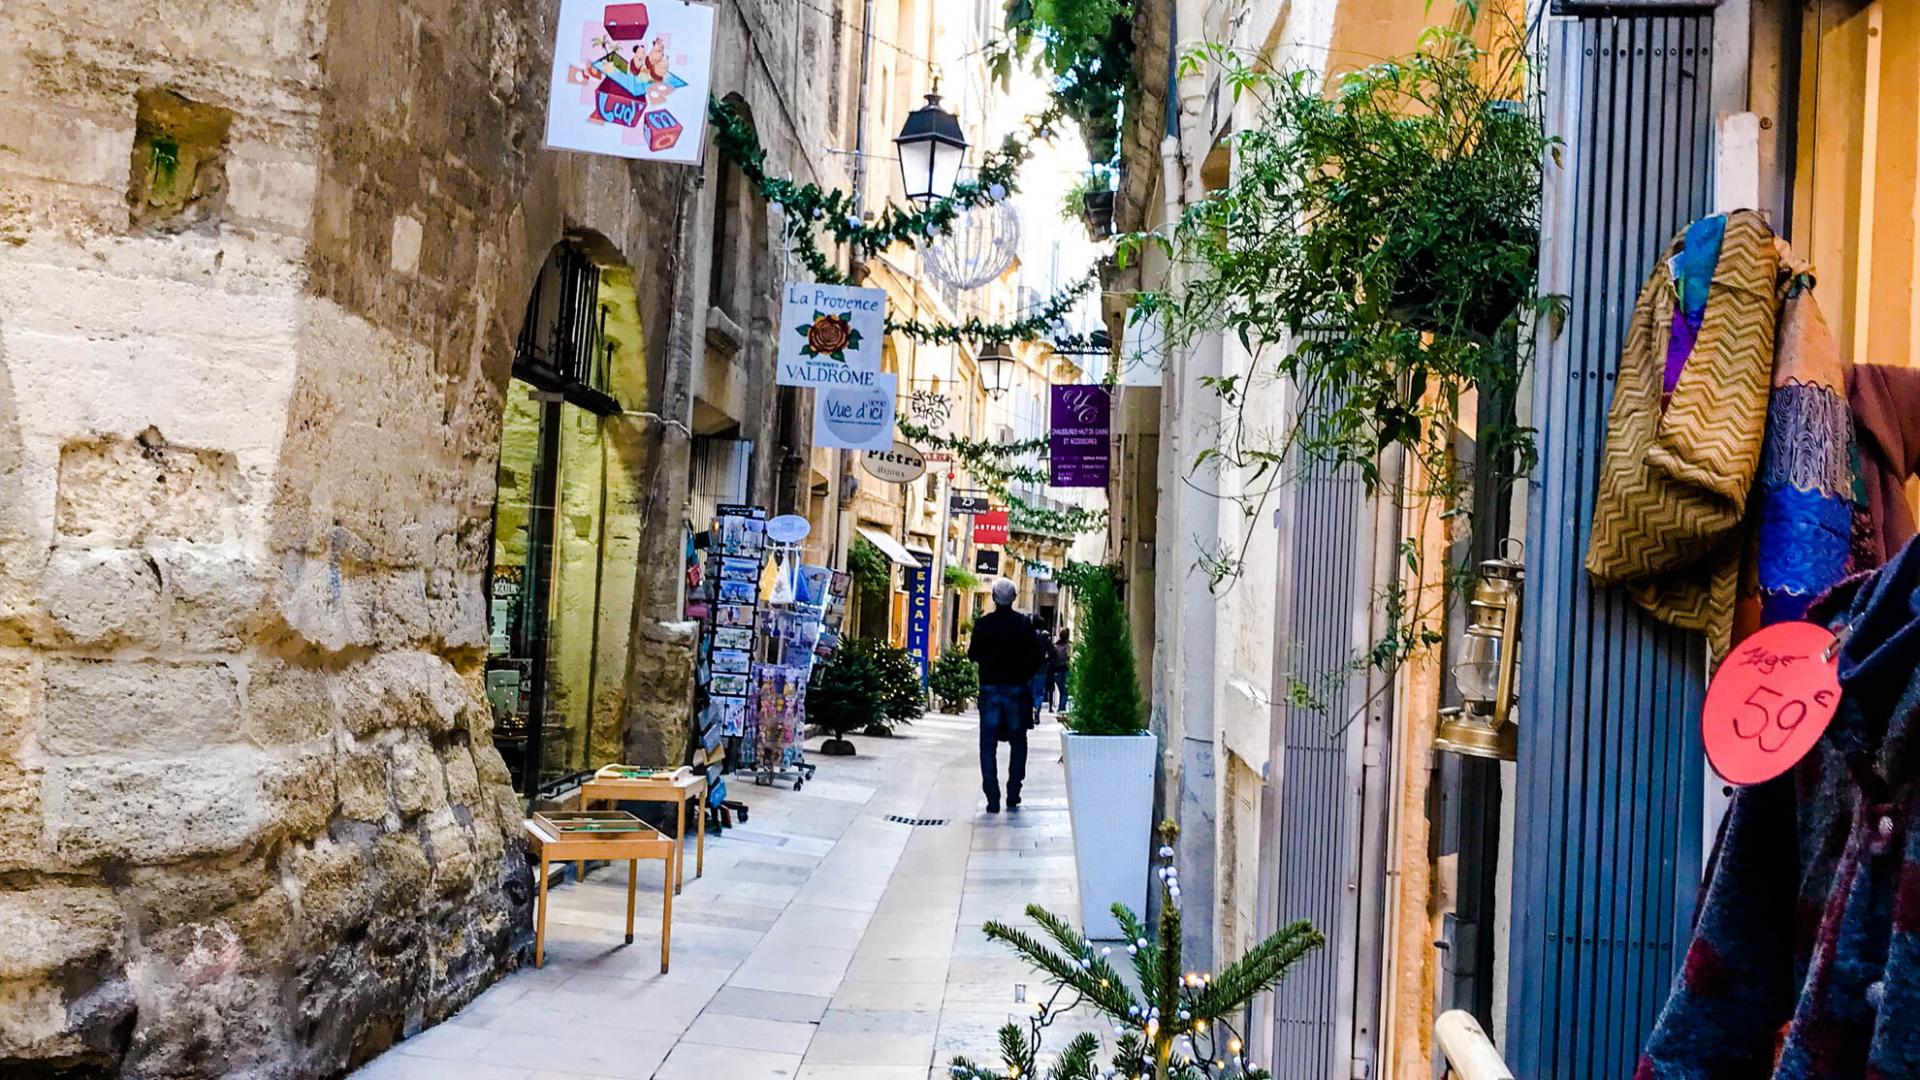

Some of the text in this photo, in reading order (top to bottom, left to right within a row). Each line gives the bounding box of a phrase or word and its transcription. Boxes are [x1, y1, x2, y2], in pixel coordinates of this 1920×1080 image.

[789, 288, 878, 311] La Provence
[785, 364, 874, 386] VALDRÔME
[826, 400, 883, 420] Vue d'ici
[913, 571, 926, 657] EXCALIB
